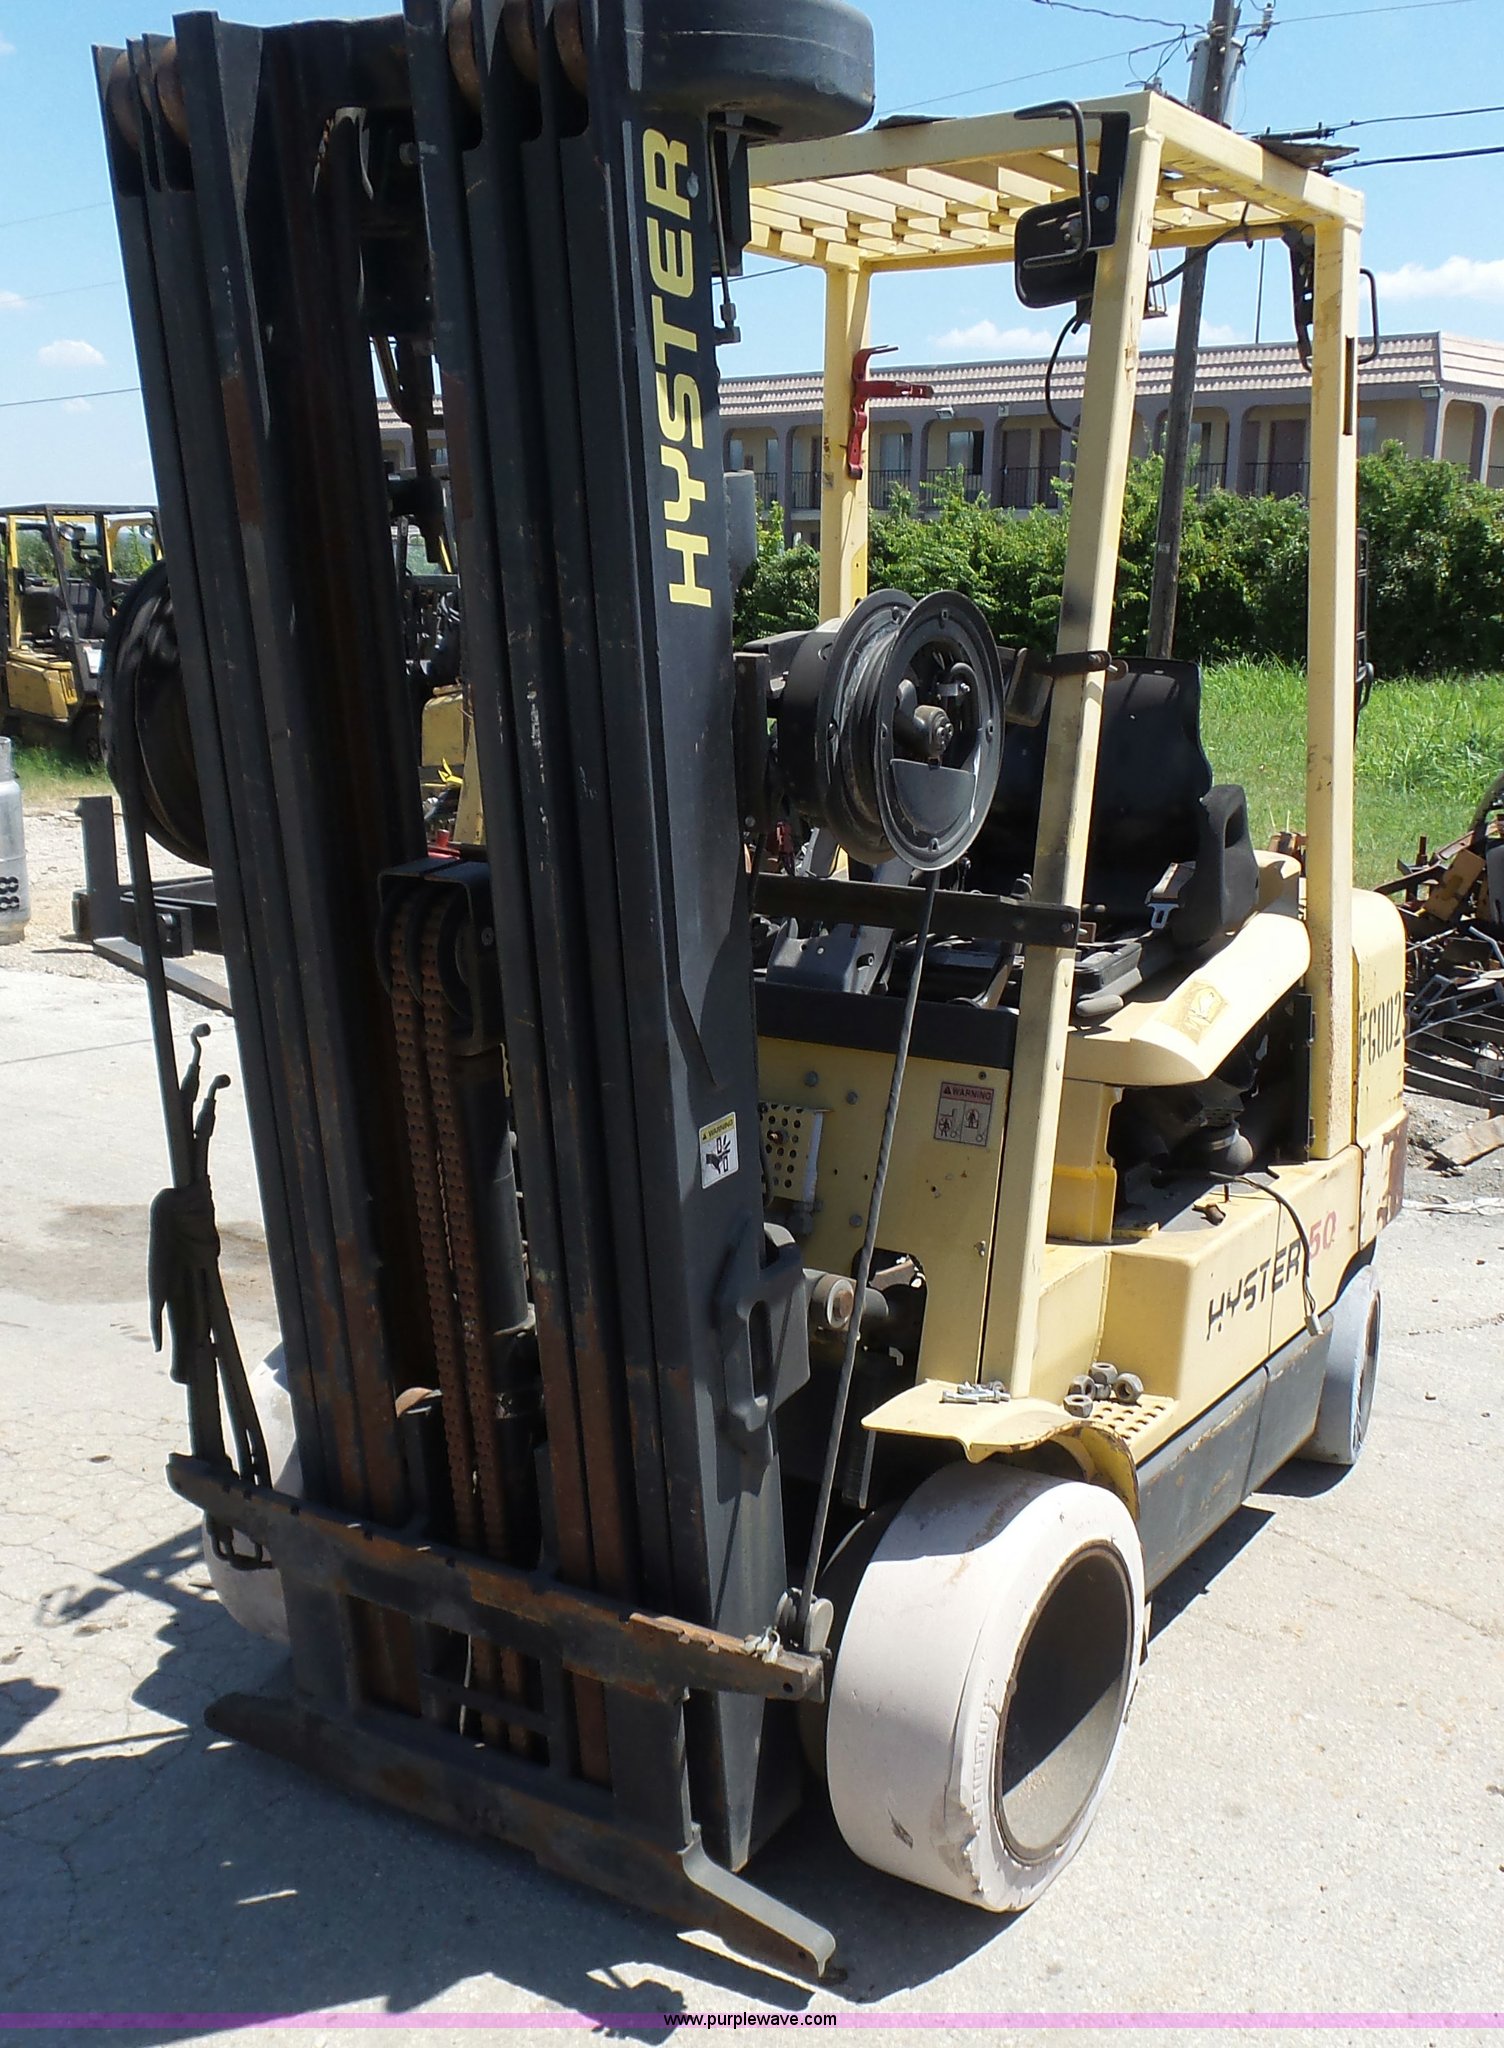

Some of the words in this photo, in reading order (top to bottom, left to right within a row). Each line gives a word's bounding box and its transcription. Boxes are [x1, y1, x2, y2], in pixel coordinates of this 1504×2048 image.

[642, 127, 712, 608] HYSTER
[708, 1117, 735, 1138] WARNING
[952, 1086, 993, 1101] WARNING
[1206, 1239, 1304, 1341] HYSTER
[1309, 1210, 1337, 1260] 50
